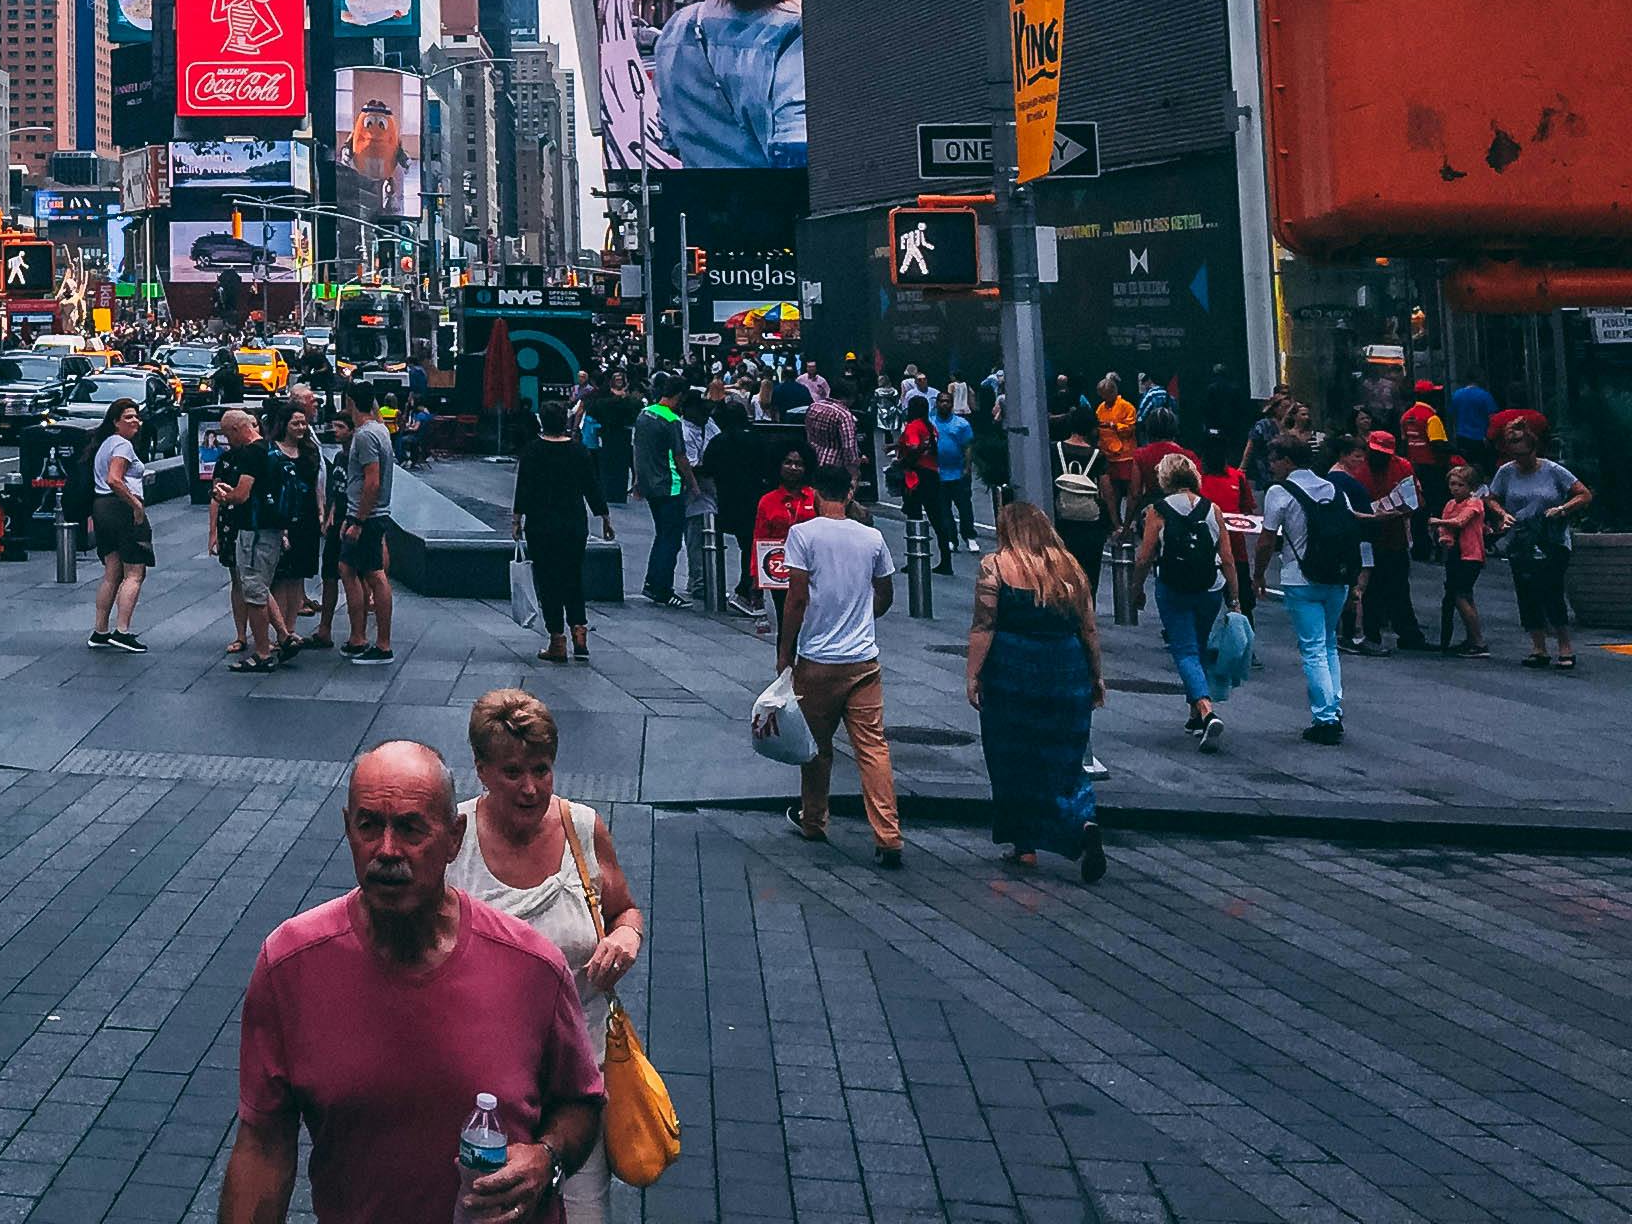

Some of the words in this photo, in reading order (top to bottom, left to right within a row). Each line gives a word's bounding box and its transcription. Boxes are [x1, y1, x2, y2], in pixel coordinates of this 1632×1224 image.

[1013, 8, 1059, 93] KING
[945, 140, 993, 161] ONE
[709, 264, 796, 292] sunglas
[498, 289, 543, 305] NYC
